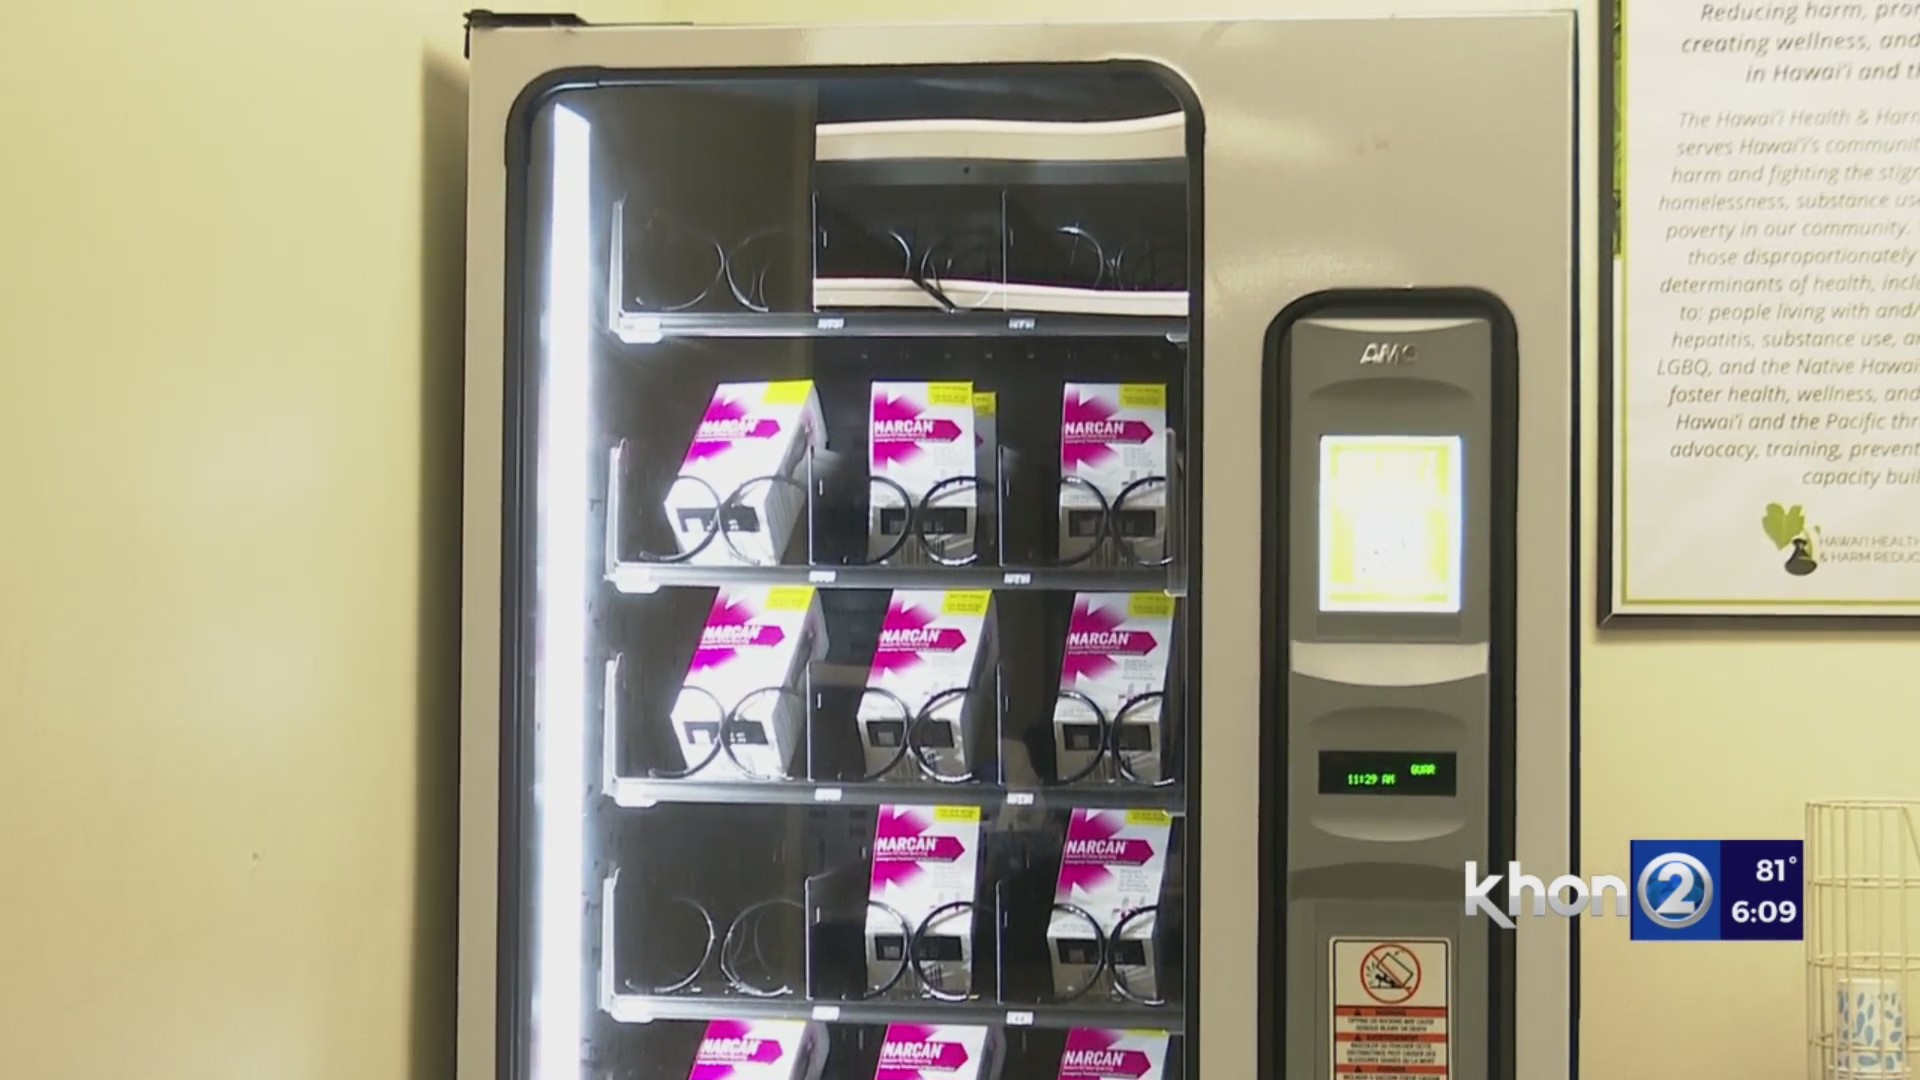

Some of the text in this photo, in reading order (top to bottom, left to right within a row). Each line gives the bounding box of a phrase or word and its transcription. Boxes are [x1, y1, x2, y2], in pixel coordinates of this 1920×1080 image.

[1700, 2, 1798, 25] Reducing
[1805, 0, 1867, 21] harm,
[1681, 33, 1770, 57] creating
[1776, 31, 1871, 53] wellness,
[1745, 63, 1766, 83] in
[1858, 61, 1901, 80] and
[1679, 111, 1711, 128] The
[1789, 108, 1851, 126] Health
[1856, 108, 1869, 125] &
[1677, 140, 1733, 156] serves
[1671, 165, 1721, 184] harm
[1727, 164, 1765, 183] and
[1767, 163, 1840, 186] fighting
[1844, 163, 1874, 181] the
[1658, 193, 1789, 212] homelessness,
[1796, 192, 1890, 209] substance
[1665, 219, 1911, 243] poverty in our community.
[1687, 246, 1917, 269] those disproportionately
[1659, 276, 1783, 294] determinants
[1789, 274, 1808, 296] of
[1813, 273, 1876, 293] health,
[1680, 305, 1703, 321] to:
[1708, 302, 1772, 325] people
[1777, 301, 1826, 324] living
[1830, 302, 1870, 320] with
[1671, 330, 1755, 352] hepatitis,
[1762, 329, 1856, 348] substance
[1860, 332, 1898, 348] use,
[1657, 358, 1712, 377] LGBQ,
[1719, 358, 1757, 376] and
[1761, 357, 1792, 375] the
[1796, 357, 1855, 375] Native
[1667, 385, 1723, 408] foster
[1727, 385, 1790, 404] health,
[1797, 384, 1878, 404] wellness,
[874, 420, 934, 434] NARCAN
[1065, 421, 1124, 435] NARCAN
[1748, 411, 1786, 430] and
[1790, 411, 1820, 430] the
[1826, 411, 1887, 435] Pacific
[1669, 441, 1760, 462] advocacy,
[1766, 440, 1842, 462] training,
[1802, 469, 1881, 490] capacity
[1831, 551, 1871, 562] HARM
[882, 629, 942, 645] NARCAN
[1069, 632, 1129, 646] NARCAN
[1348, 773, 1378, 785] 11:29
[877, 836, 938, 852] NARCAN
[1067, 840, 1128, 855] NARCAN
[885, 1041, 945, 1060] NARCAN
[1064, 1050, 1125, 1067] NARCAN
